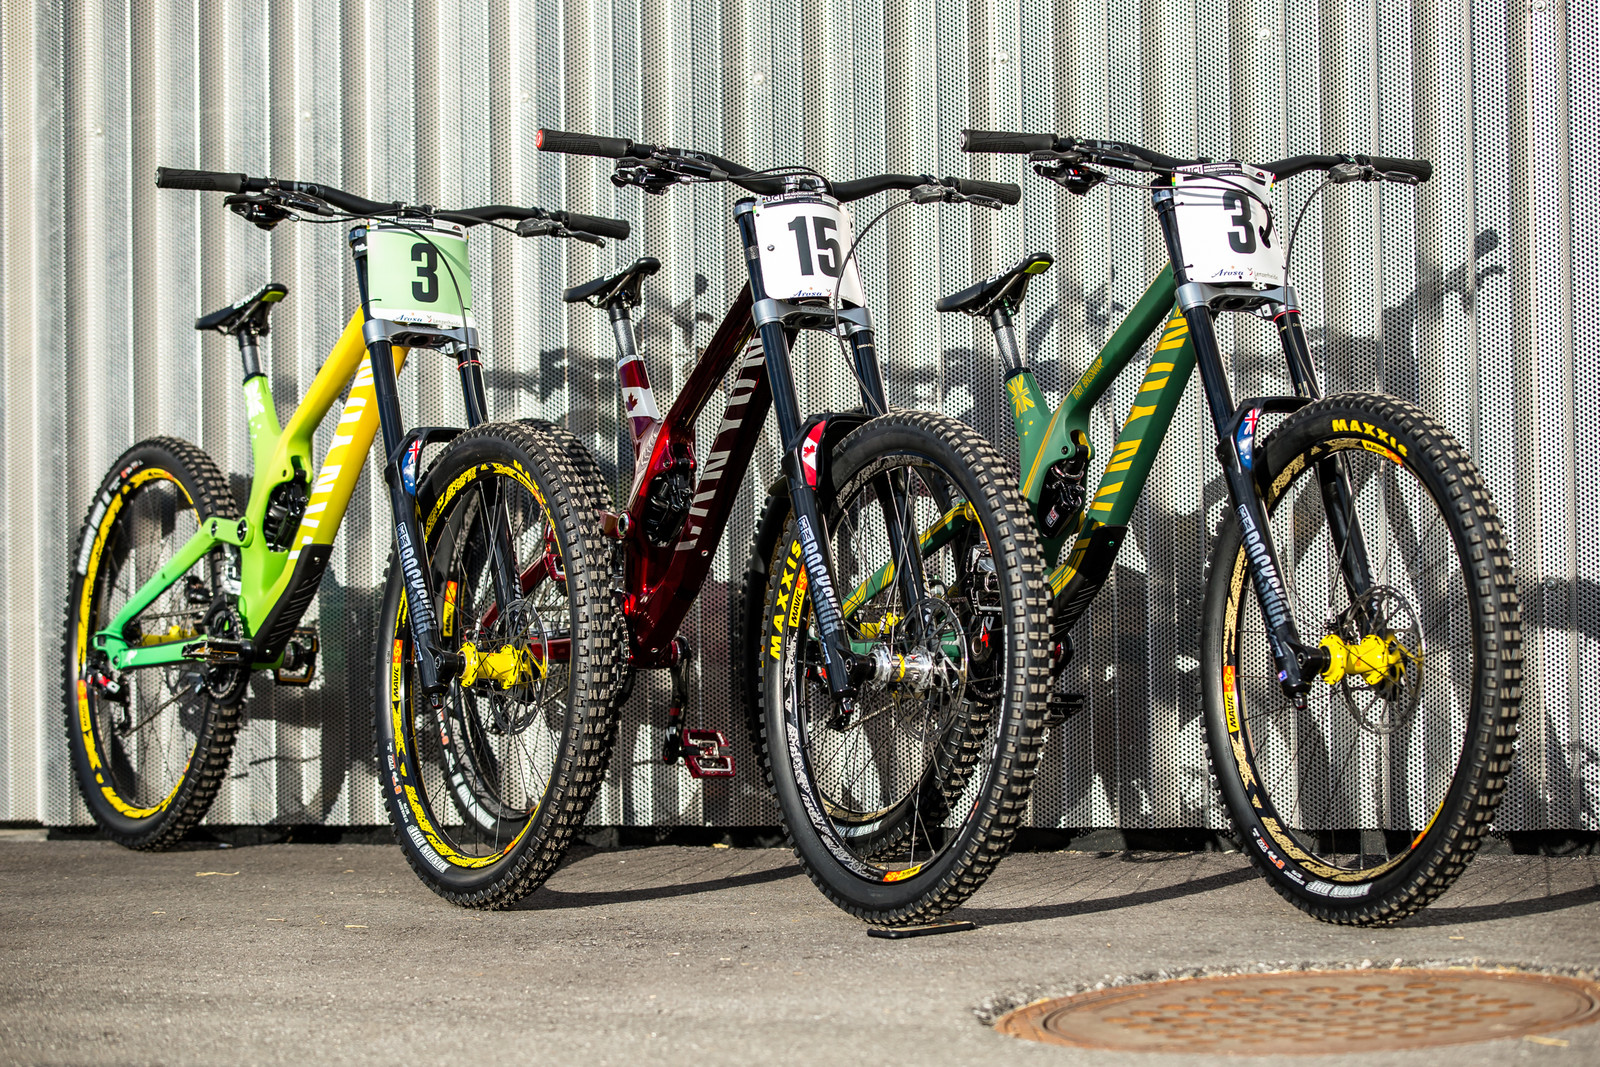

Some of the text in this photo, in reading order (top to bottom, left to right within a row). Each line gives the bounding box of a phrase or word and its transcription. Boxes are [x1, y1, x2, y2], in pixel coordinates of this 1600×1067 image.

[766, 194, 783, 203] UCI
[1223, 189, 1257, 254] 3
[788, 215, 842, 278] 15
[411, 243, 439, 303] 3
[1211, 268, 1244, 278] Arosa
[791, 289, 822, 297] Arosa
[392, 314, 423, 322] Arosa
[1071, 382, 1085, 400] TROY
[675, 337, 765, 551] CANYON
[1332, 419, 1407, 457] MAXXIS
[399, 546, 437, 635] ROCKSHOX
[801, 541, 844, 635] ROCKSHOX
[1244, 529, 1294, 628] ROCKSHOX
[770, 540, 802, 660] MAXXIS
[790, 589, 803, 625] MAVIC
[393, 665, 401, 701] MAVIC
[1226, 694, 1239, 729] MAVIC
[406, 824, 451, 873] MINION DHF
[1305, 879, 1373, 898] MINION DHF
